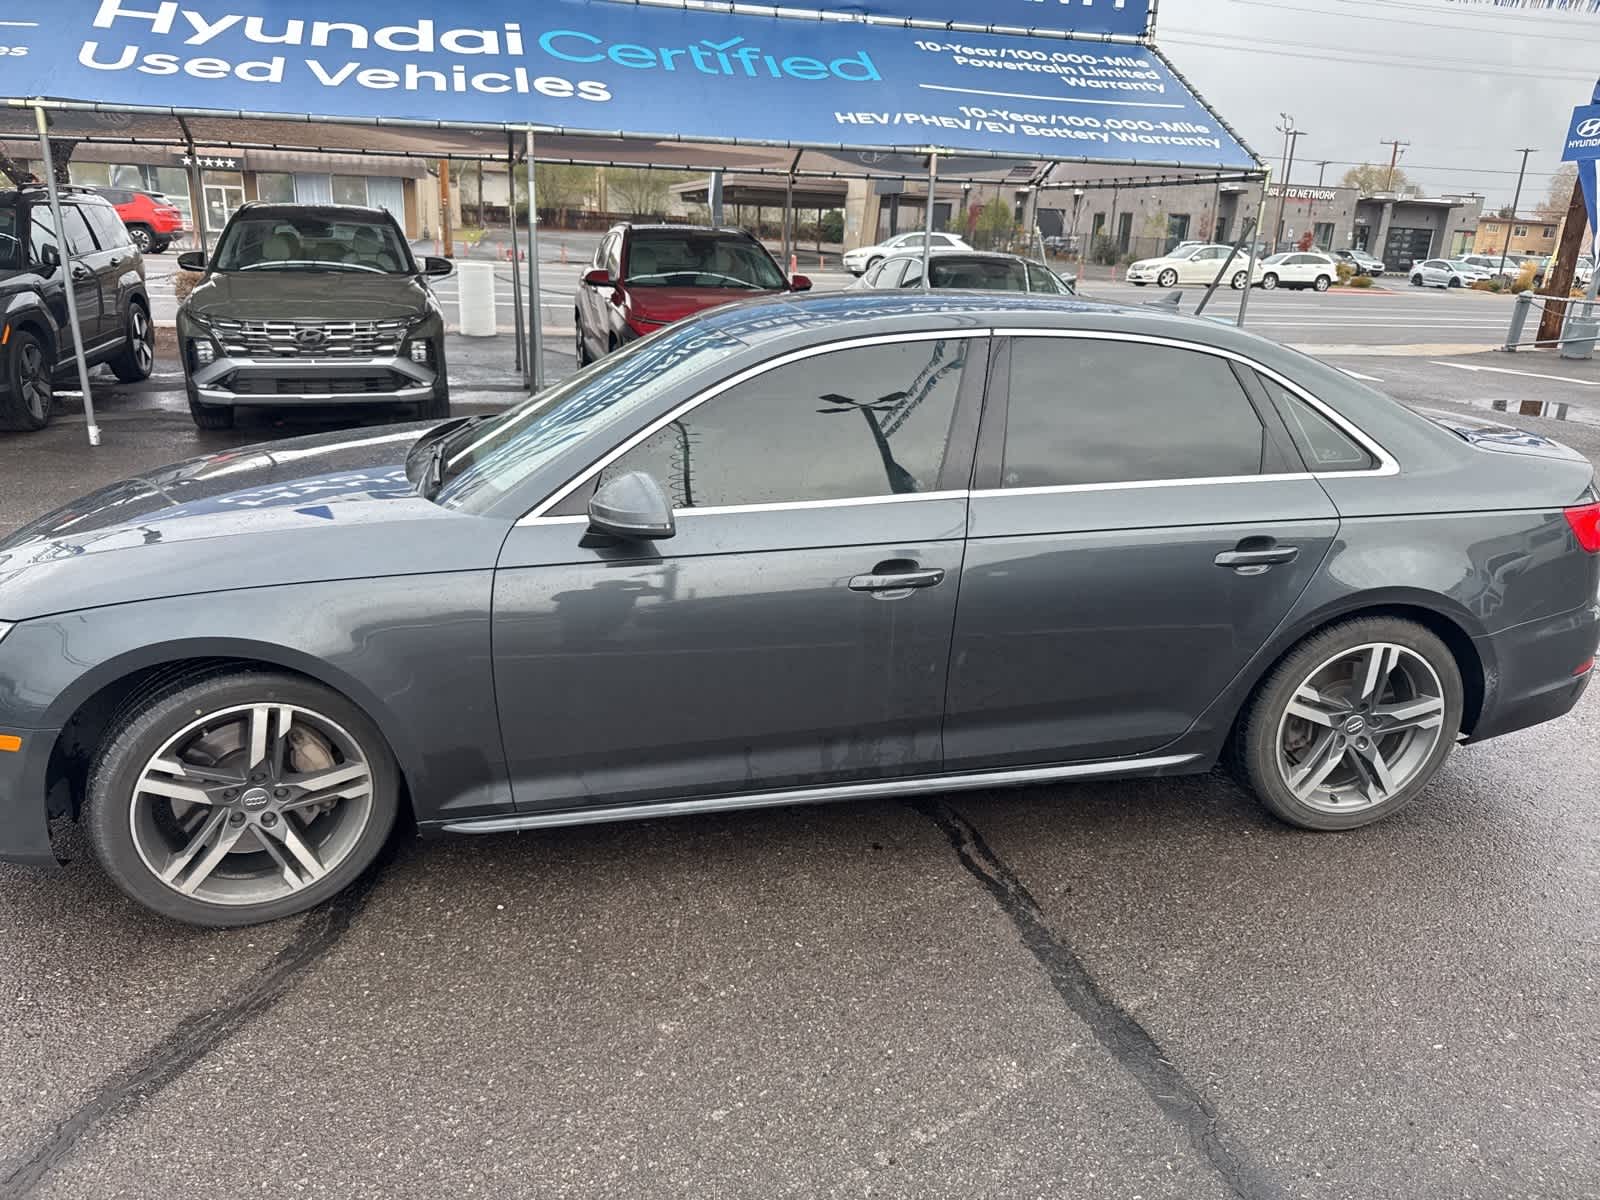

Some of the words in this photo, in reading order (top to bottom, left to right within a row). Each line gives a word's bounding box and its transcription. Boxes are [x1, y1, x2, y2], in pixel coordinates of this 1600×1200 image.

[93, 0, 524, 55] Hyundai
[537, 29, 882, 81] Certified
[78, 41, 285, 83] Used
[305, 59, 612, 102] Vehicles
[953, 55, 1077, 75] Powertrain
[1078, 66, 1161, 80] Limited
[1061, 76, 1165, 93] Warranty
[1019, 124, 1109, 143] Battery
[1110, 131, 1221, 149] Warranty
[1297, 189, 1337, 200] NETWORK
